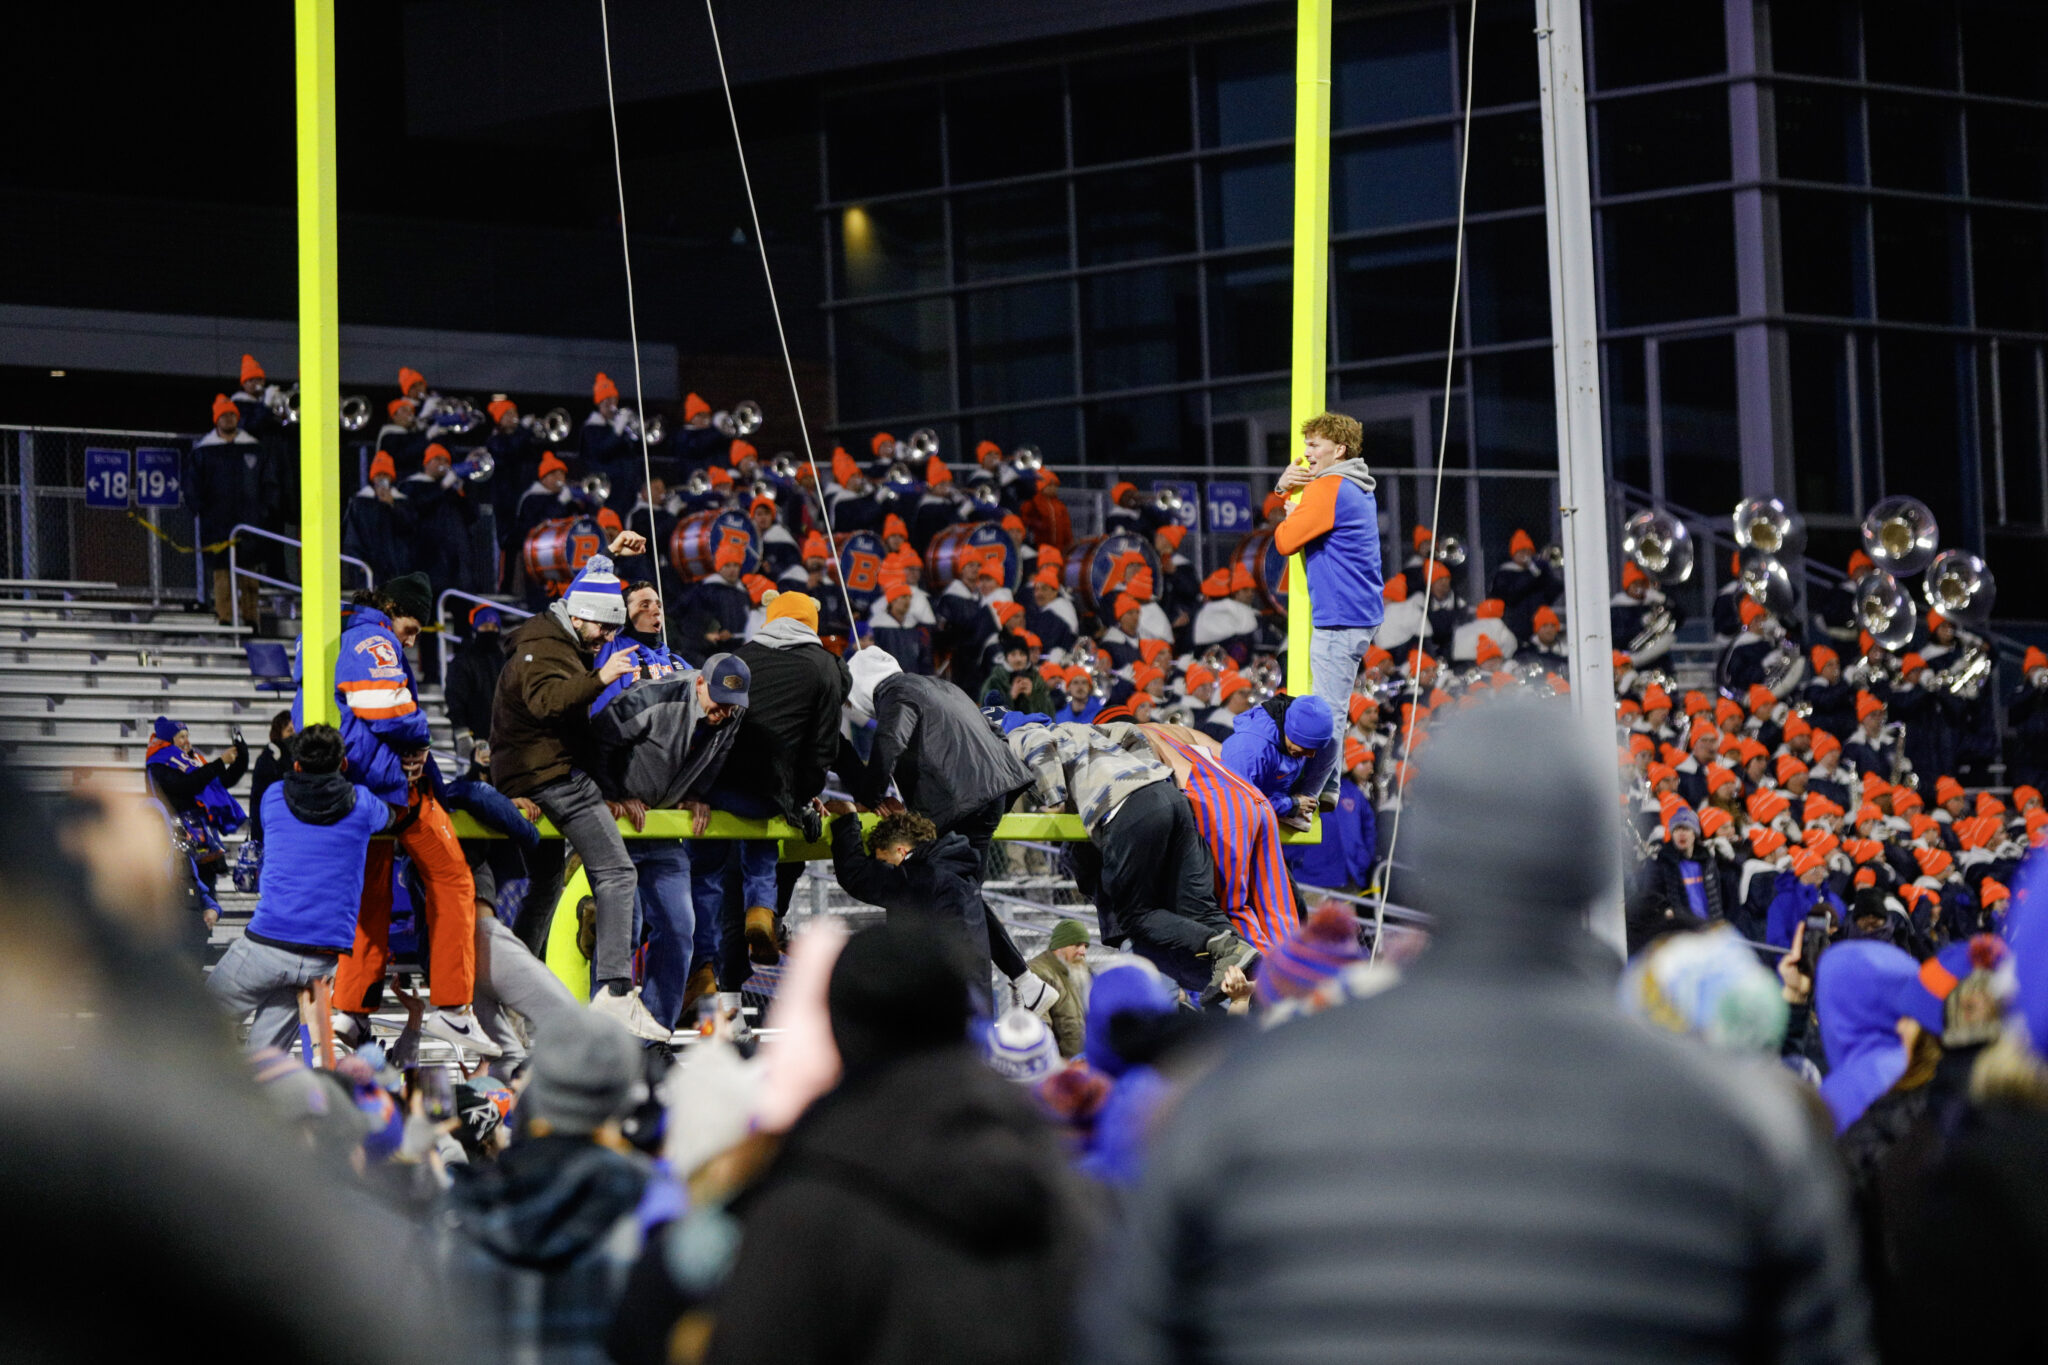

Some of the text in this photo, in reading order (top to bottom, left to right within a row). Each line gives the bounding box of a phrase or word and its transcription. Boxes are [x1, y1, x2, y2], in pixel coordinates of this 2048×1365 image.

[101, 471, 127, 498] 18
[138, 470, 165, 497] 19
[1209, 501, 1237, 527] 19
[572, 534, 600, 569] B
[848, 550, 881, 592] B
